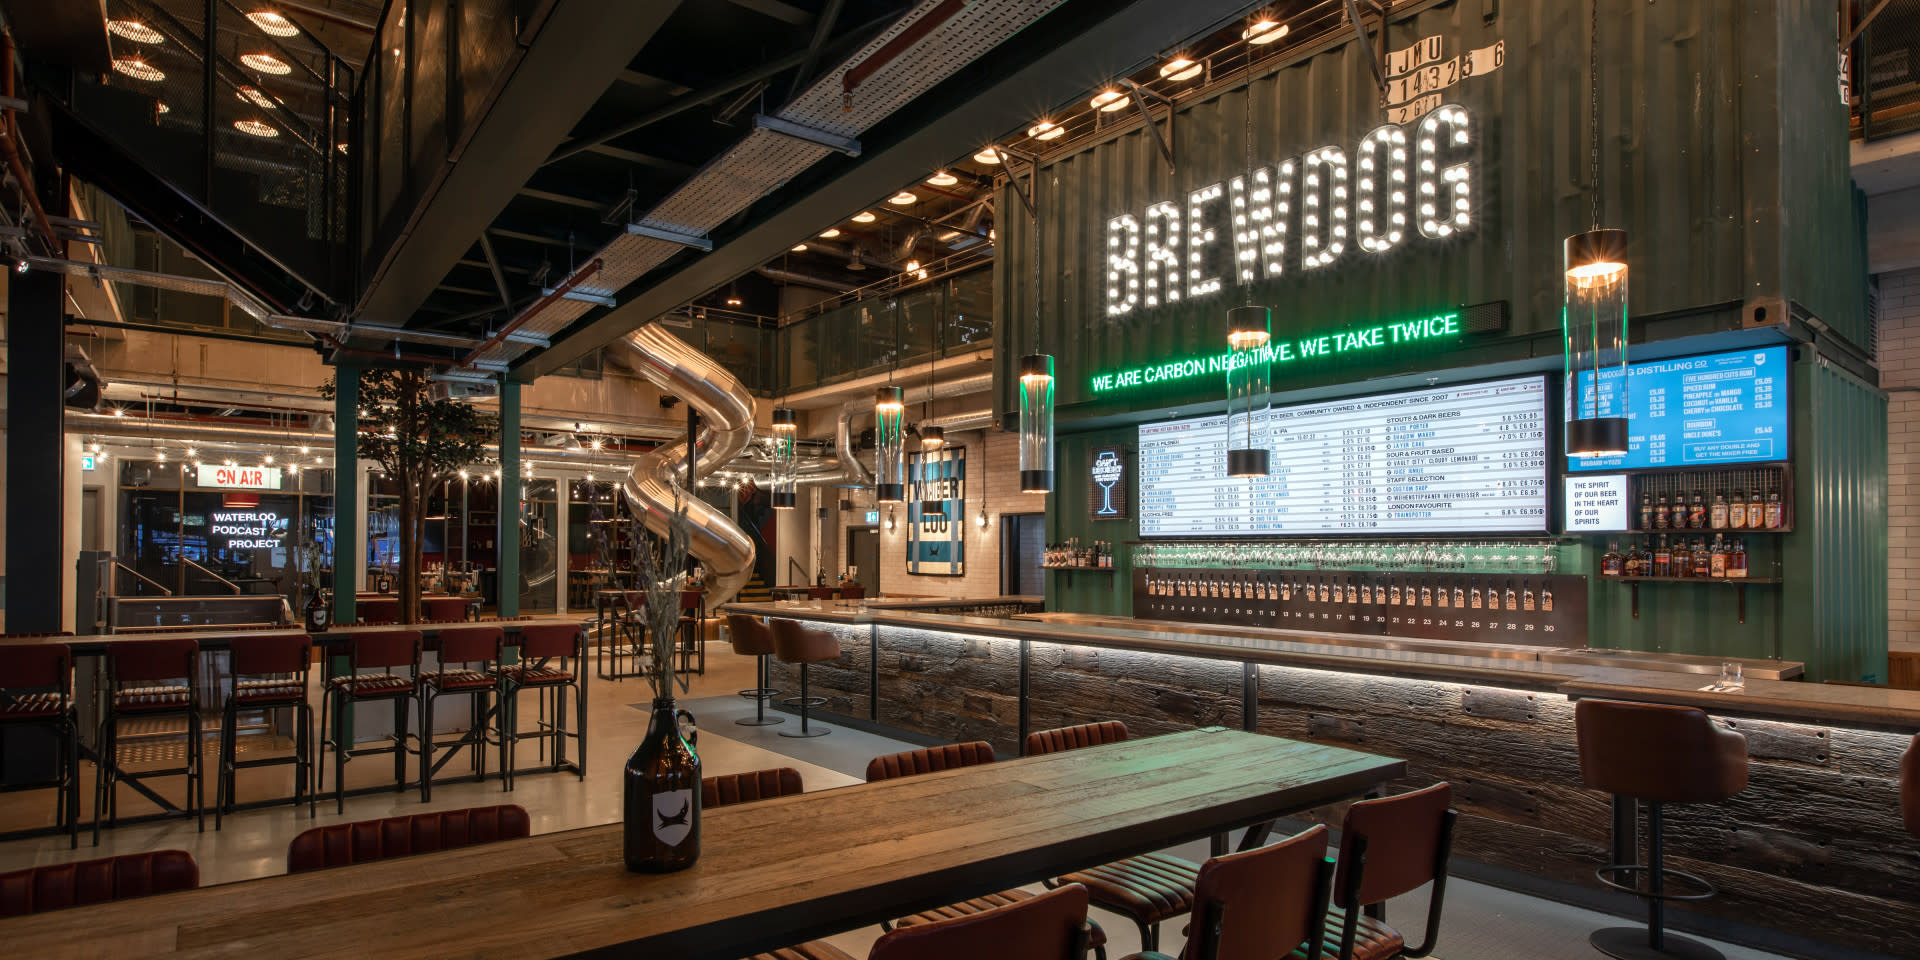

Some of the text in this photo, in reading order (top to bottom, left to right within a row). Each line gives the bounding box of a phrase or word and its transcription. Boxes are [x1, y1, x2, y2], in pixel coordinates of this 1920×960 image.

[1495, 42, 1503, 67] 6
[1105, 104, 1471, 316] BREWDOG
[1093, 375, 1113, 391] WE
[1115, 370, 1142, 388] ARE
[1144, 358, 1205, 383] CARBON
[1300, 337, 1330, 358] WE
[1333, 328, 1384, 351] TAKE
[1388, 314, 1459, 342] TWICE
[1636, 362, 1693, 375] DISTILLING
[1297, 408, 1331, 416] COMMUNITY
[1333, 405, 1354, 413] OWNED
[1364, 400, 1407, 408] INDEPENDENT
[1711, 404, 1743, 412] CHOCOLATE
[1438, 411, 1461, 419] BEERS
[217, 469, 262, 485] ON AIR
[214, 512, 276, 522] WATERLOO
[212, 526, 267, 535] PODCAST
[229, 540, 280, 548] PROJECT
